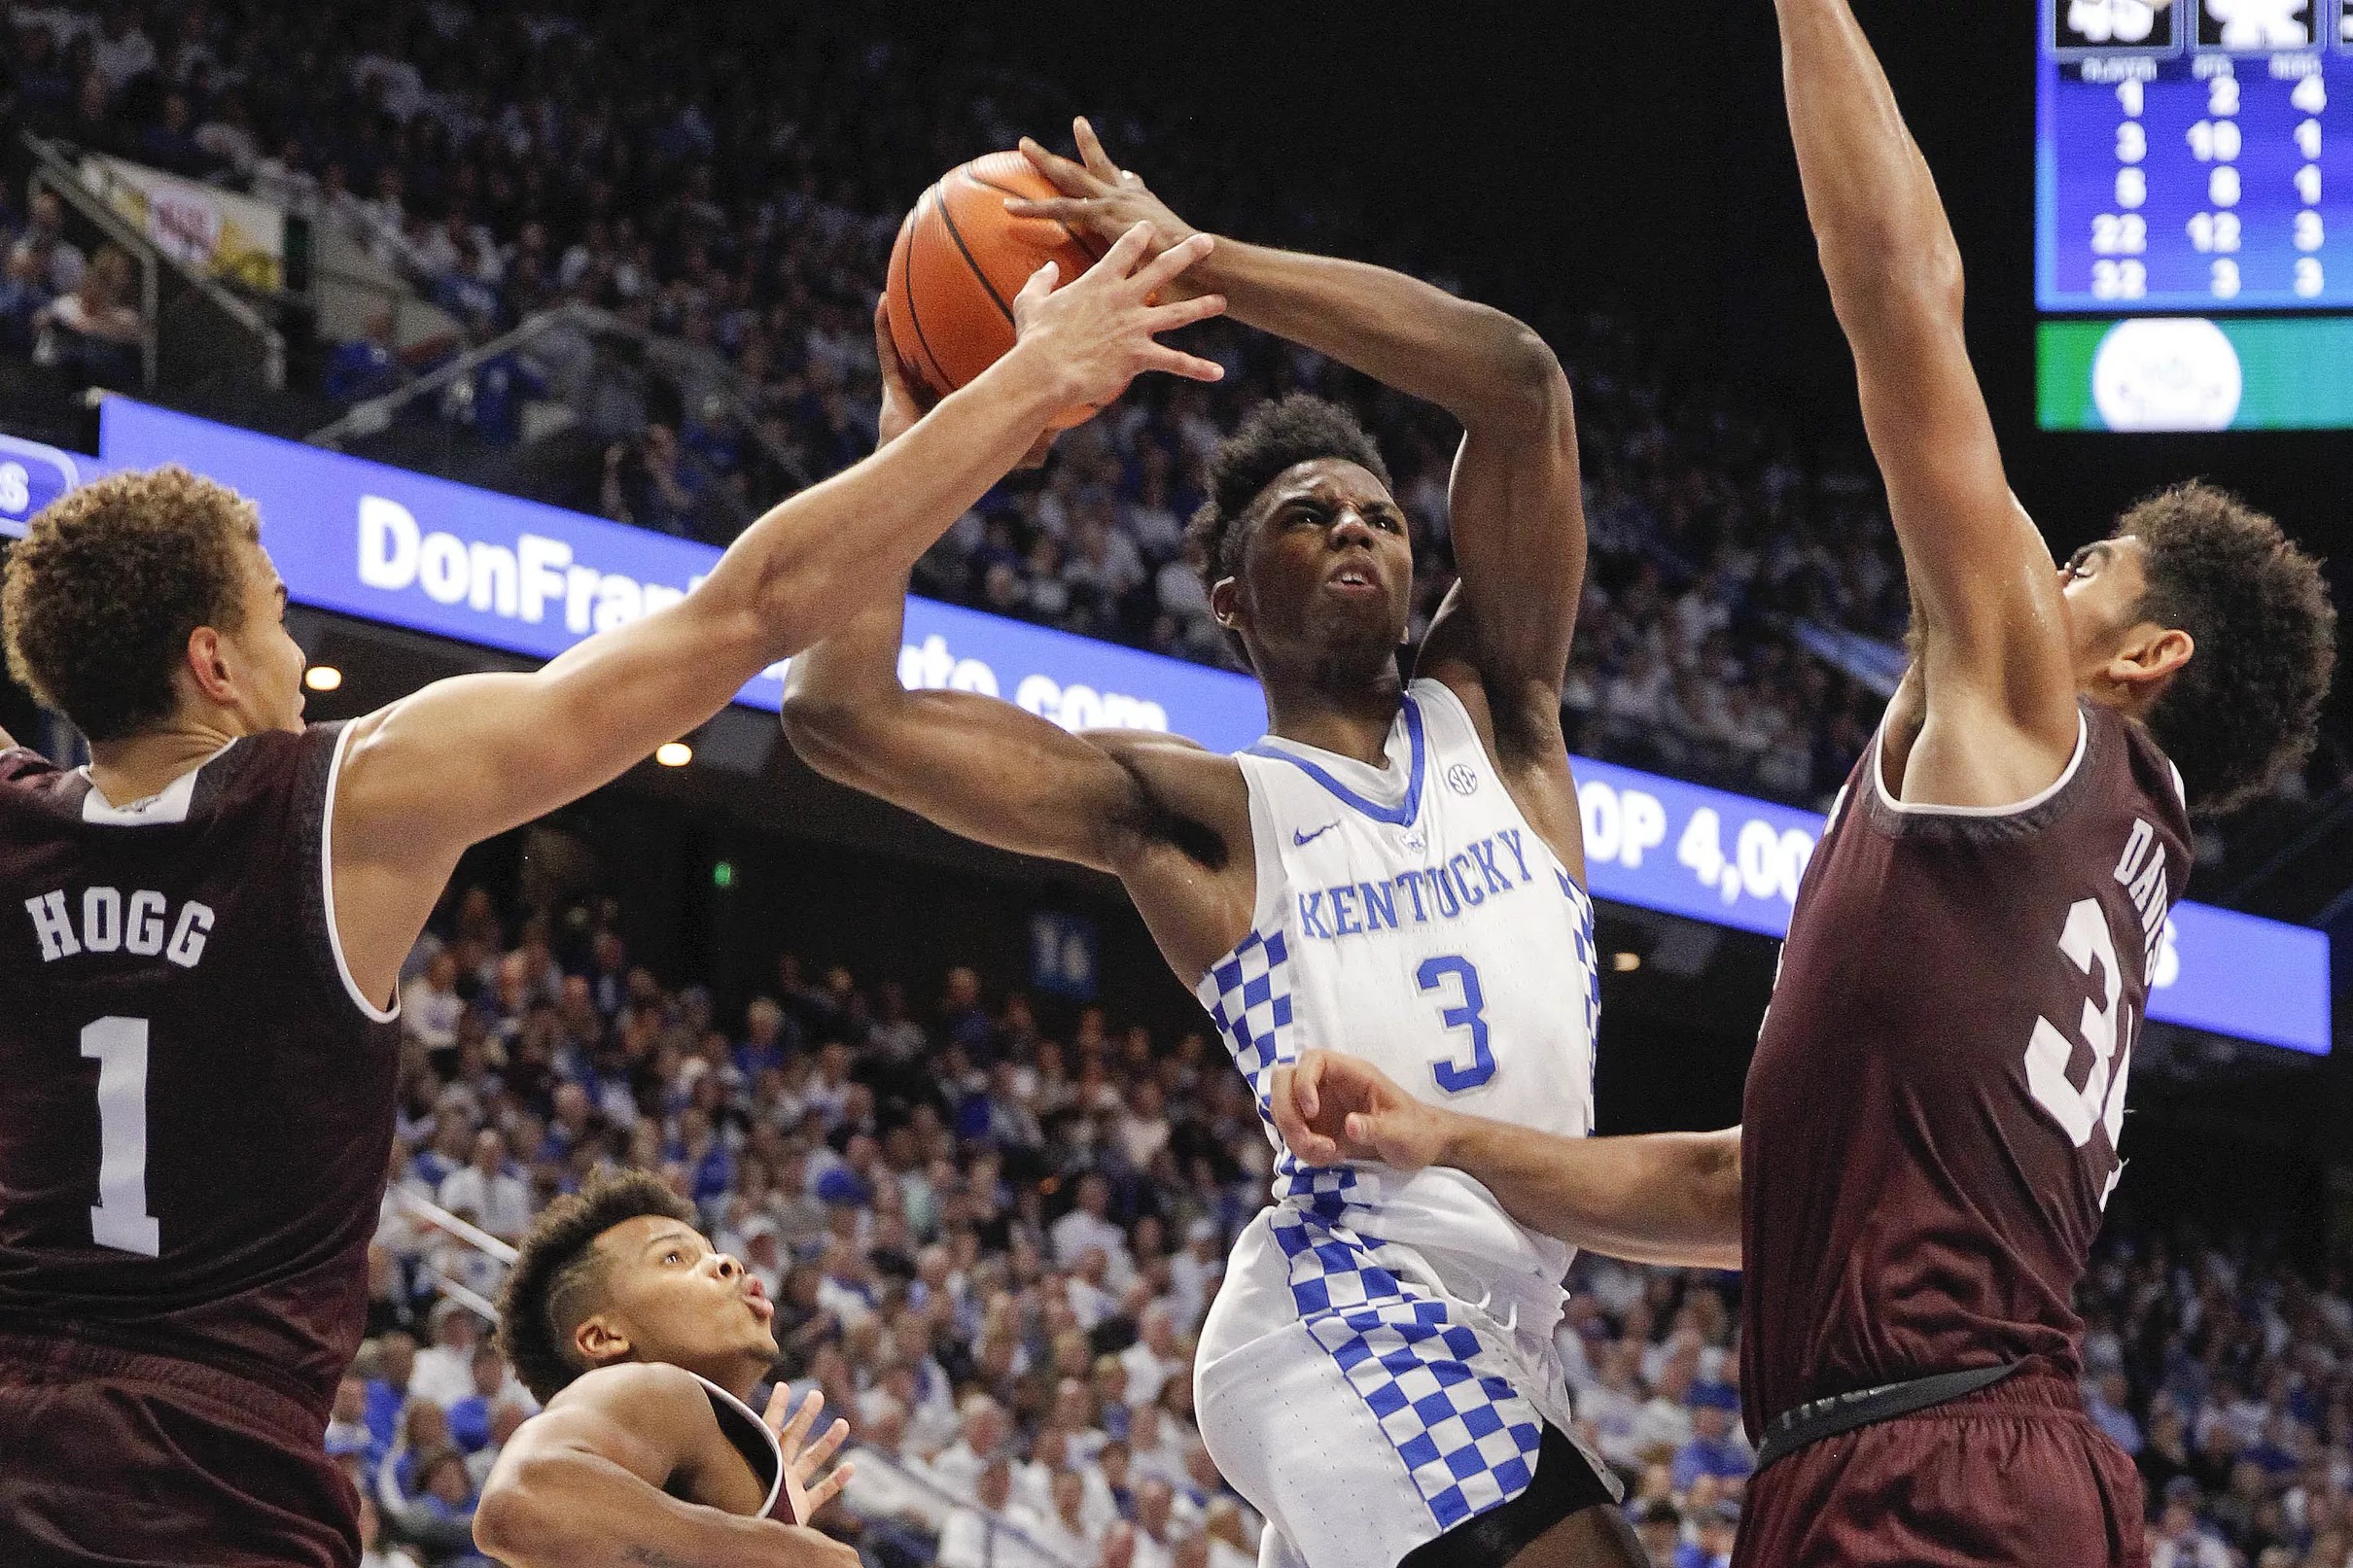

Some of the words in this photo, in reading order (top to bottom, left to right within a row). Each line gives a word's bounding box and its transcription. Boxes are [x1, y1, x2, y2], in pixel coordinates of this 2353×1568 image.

[1297, 828, 1533, 940] KENTUCKY
[1577, 780, 1668, 870] OP
[1675, 806, 1815, 906] 4,00
[24, 886, 216, 968] HOGG
[1416, 955, 1497, 1094] 3
[81, 1015, 159, 1258] 1
